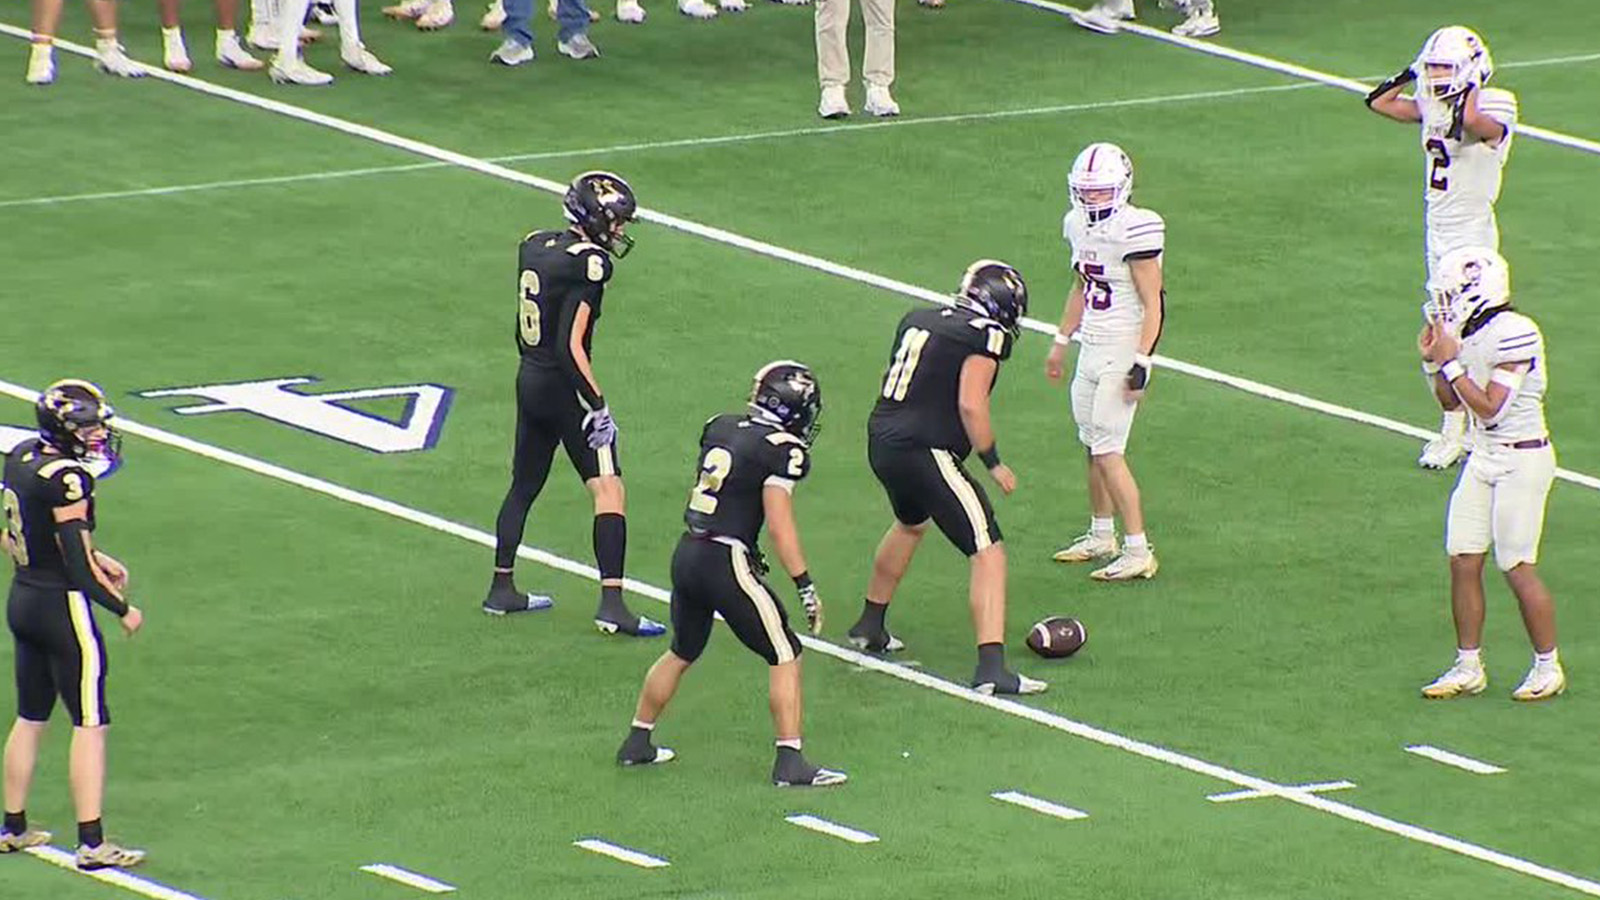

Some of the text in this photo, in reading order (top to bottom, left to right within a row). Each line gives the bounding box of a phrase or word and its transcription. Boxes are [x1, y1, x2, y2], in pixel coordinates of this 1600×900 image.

[1426, 138, 1450, 191] 2
[587, 254, 603, 281] 6
[520, 270, 541, 346] 6
[987, 327, 1004, 355] 11
[883, 327, 930, 401] 11
[689, 447, 732, 515] 2
[787, 448, 804, 476] 2
[63, 473, 82, 500] 3
